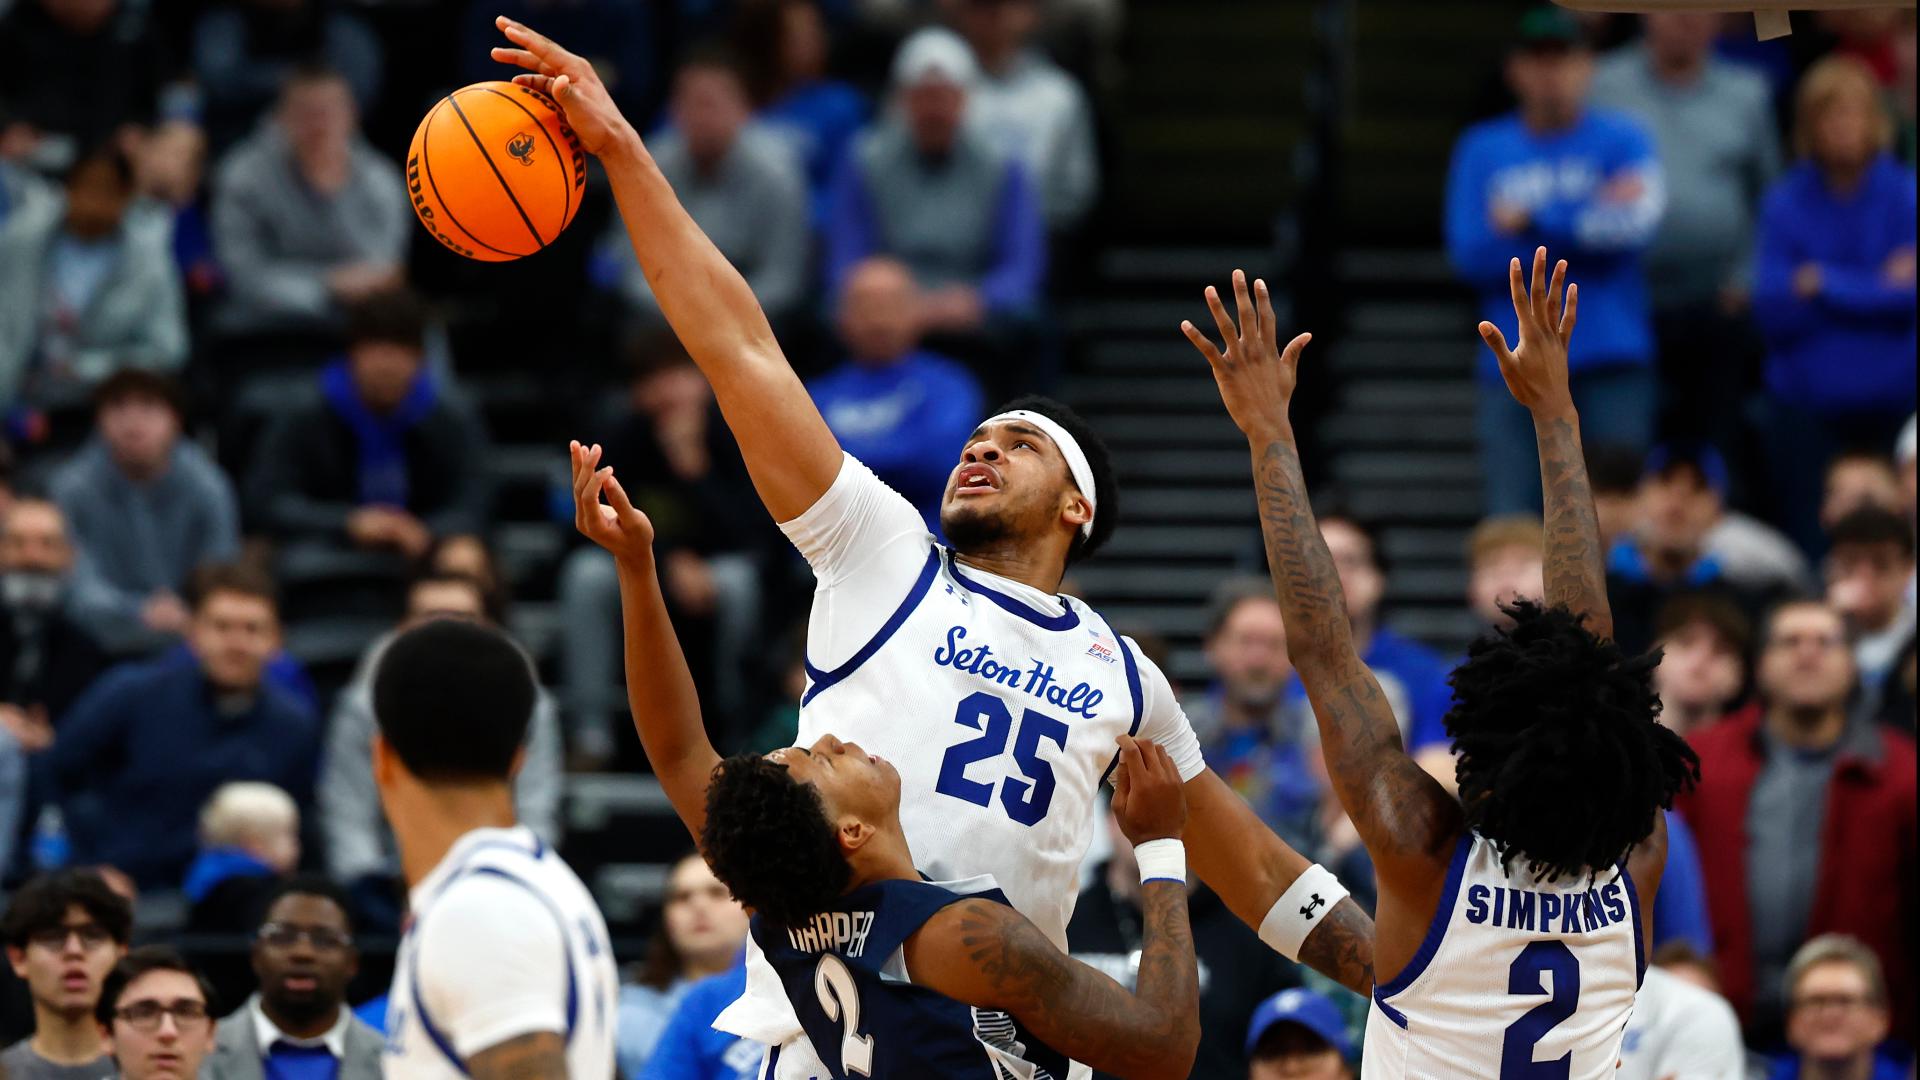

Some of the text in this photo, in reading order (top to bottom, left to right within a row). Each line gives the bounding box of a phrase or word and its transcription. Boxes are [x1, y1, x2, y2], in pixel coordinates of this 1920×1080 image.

[407, 152, 474, 257] Wilson
[934, 625, 1104, 719] Seton Hall
[1088, 648, 1117, 664] EAST
[1092, 643, 1112, 656] BIG
[935, 691, 1069, 827] 25
[1466, 883, 1626, 934] SIMPKINS
[814, 953, 875, 1077] 2
[1499, 939, 1581, 1080] 2
